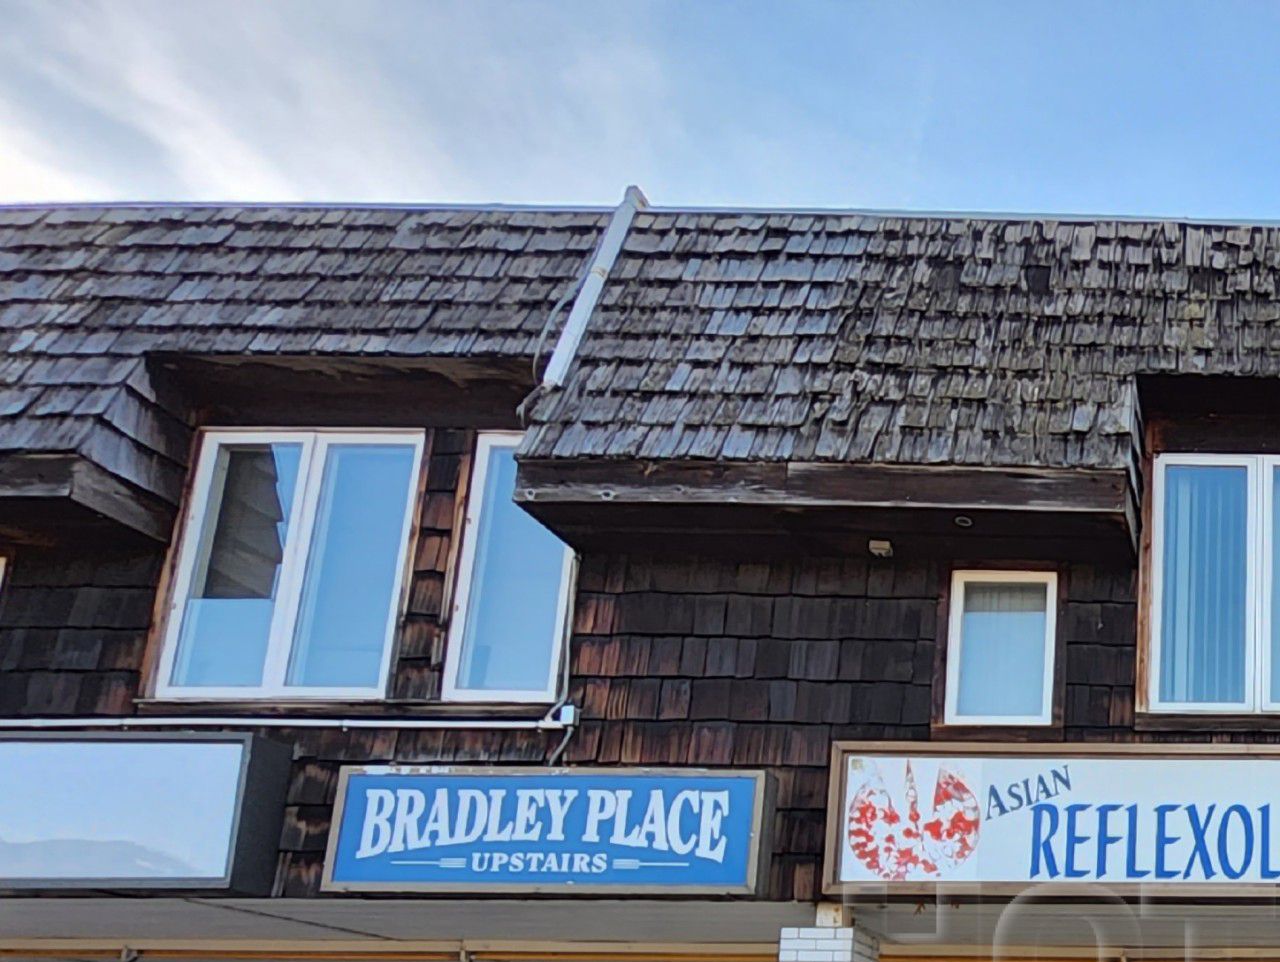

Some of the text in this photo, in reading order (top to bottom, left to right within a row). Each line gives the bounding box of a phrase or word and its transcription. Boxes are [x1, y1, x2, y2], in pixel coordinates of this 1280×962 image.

[984, 764, 1073, 822] ASIAN
[355, 788, 730, 863] BRADLEY PLACE
[471, 852, 608, 873] UPSTAIRS
